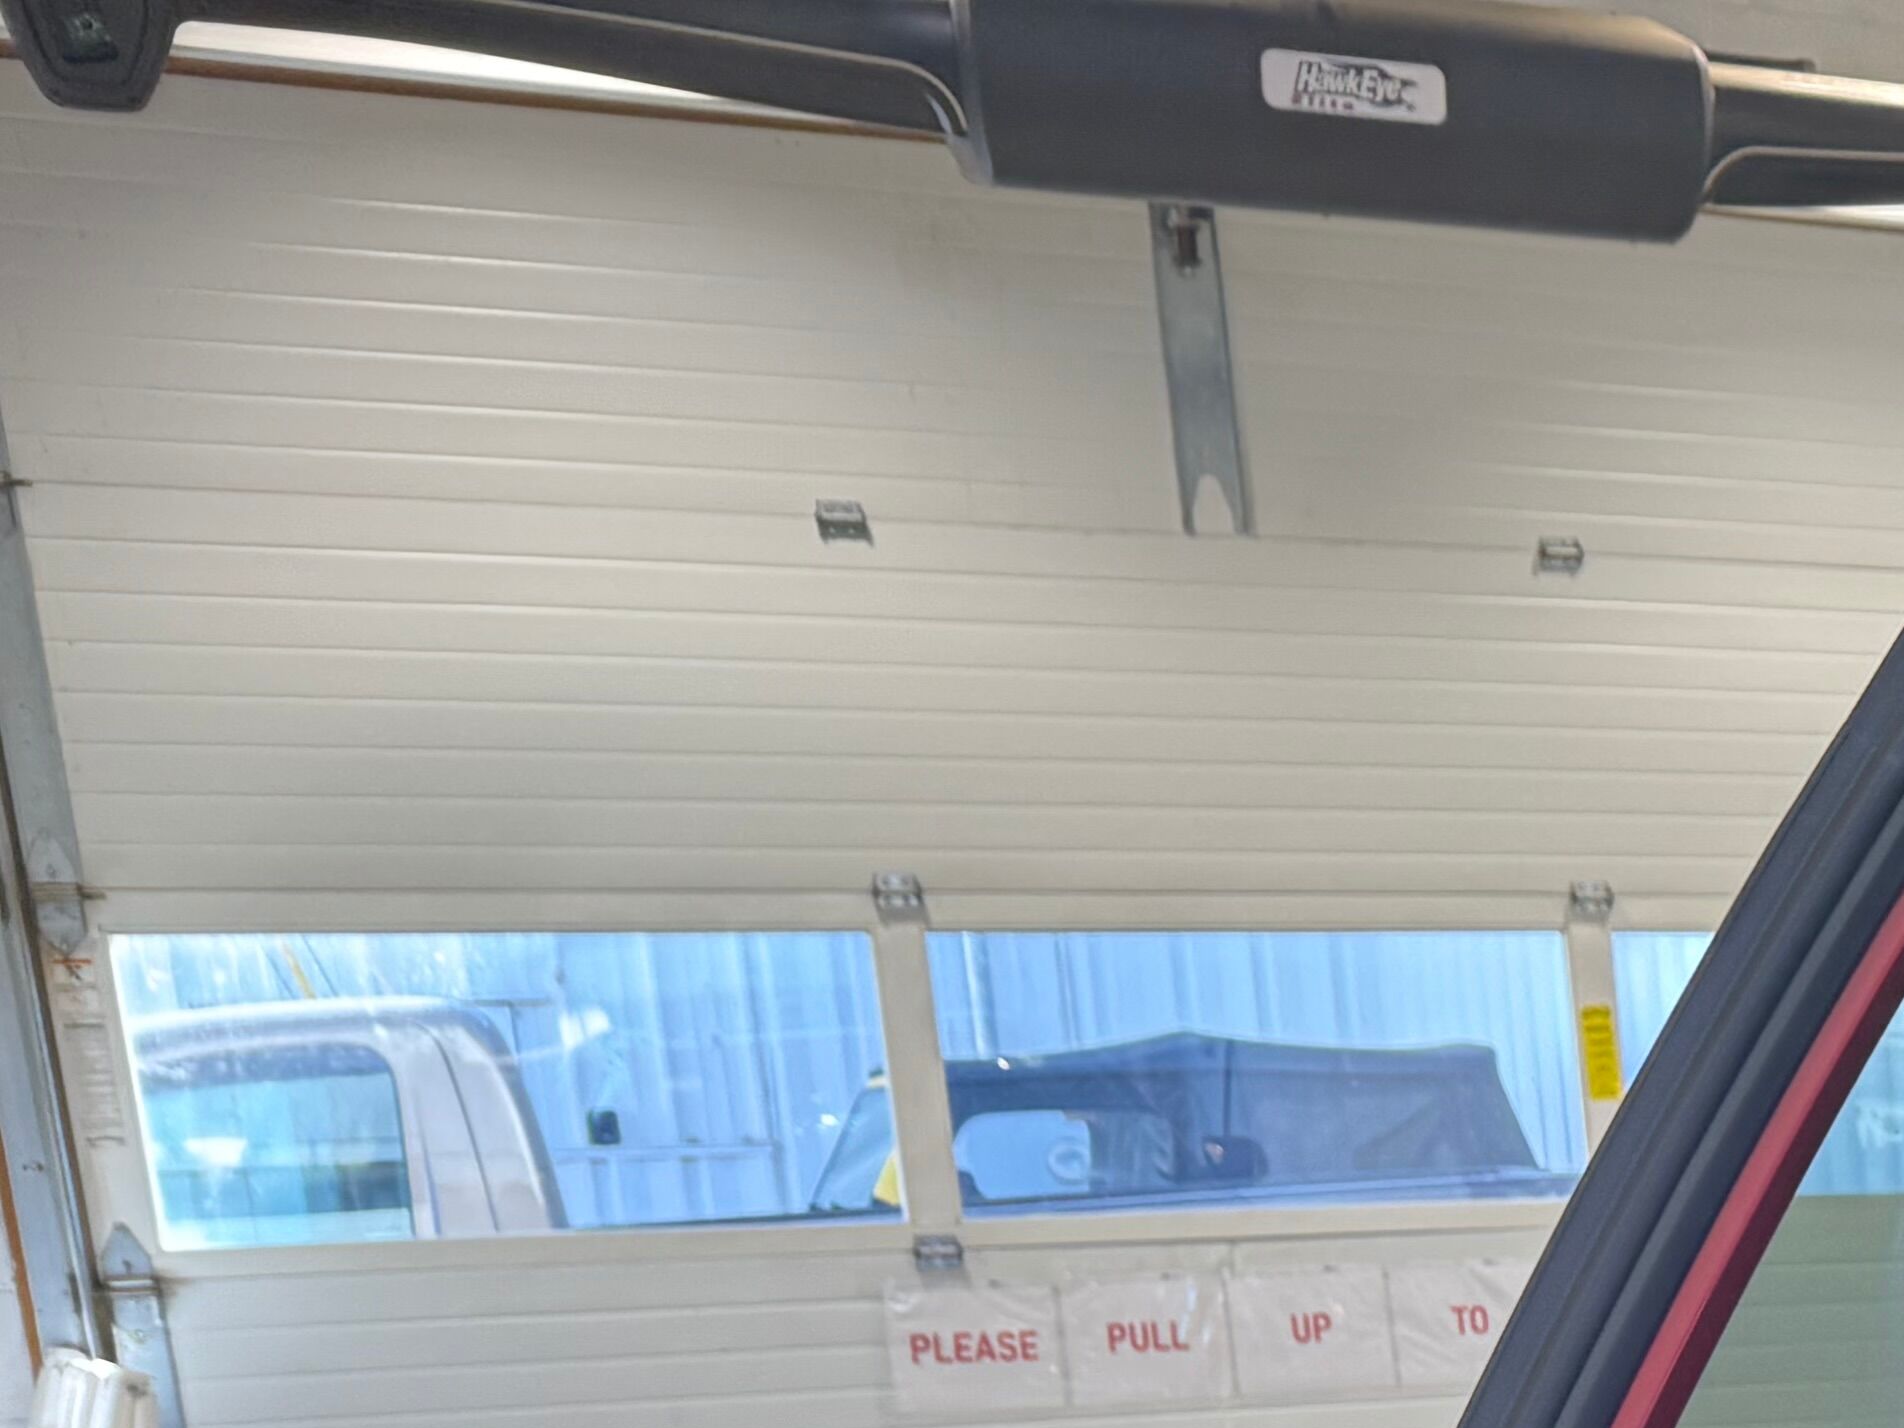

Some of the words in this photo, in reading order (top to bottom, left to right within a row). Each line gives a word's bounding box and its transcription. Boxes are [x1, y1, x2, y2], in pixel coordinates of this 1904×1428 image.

[909, 1330, 1040, 1366] PLEASE
[1107, 1320, 1190, 1354] PULL
[1291, 1312, 1332, 1344] UP
[1450, 1304, 1490, 1337] TO
